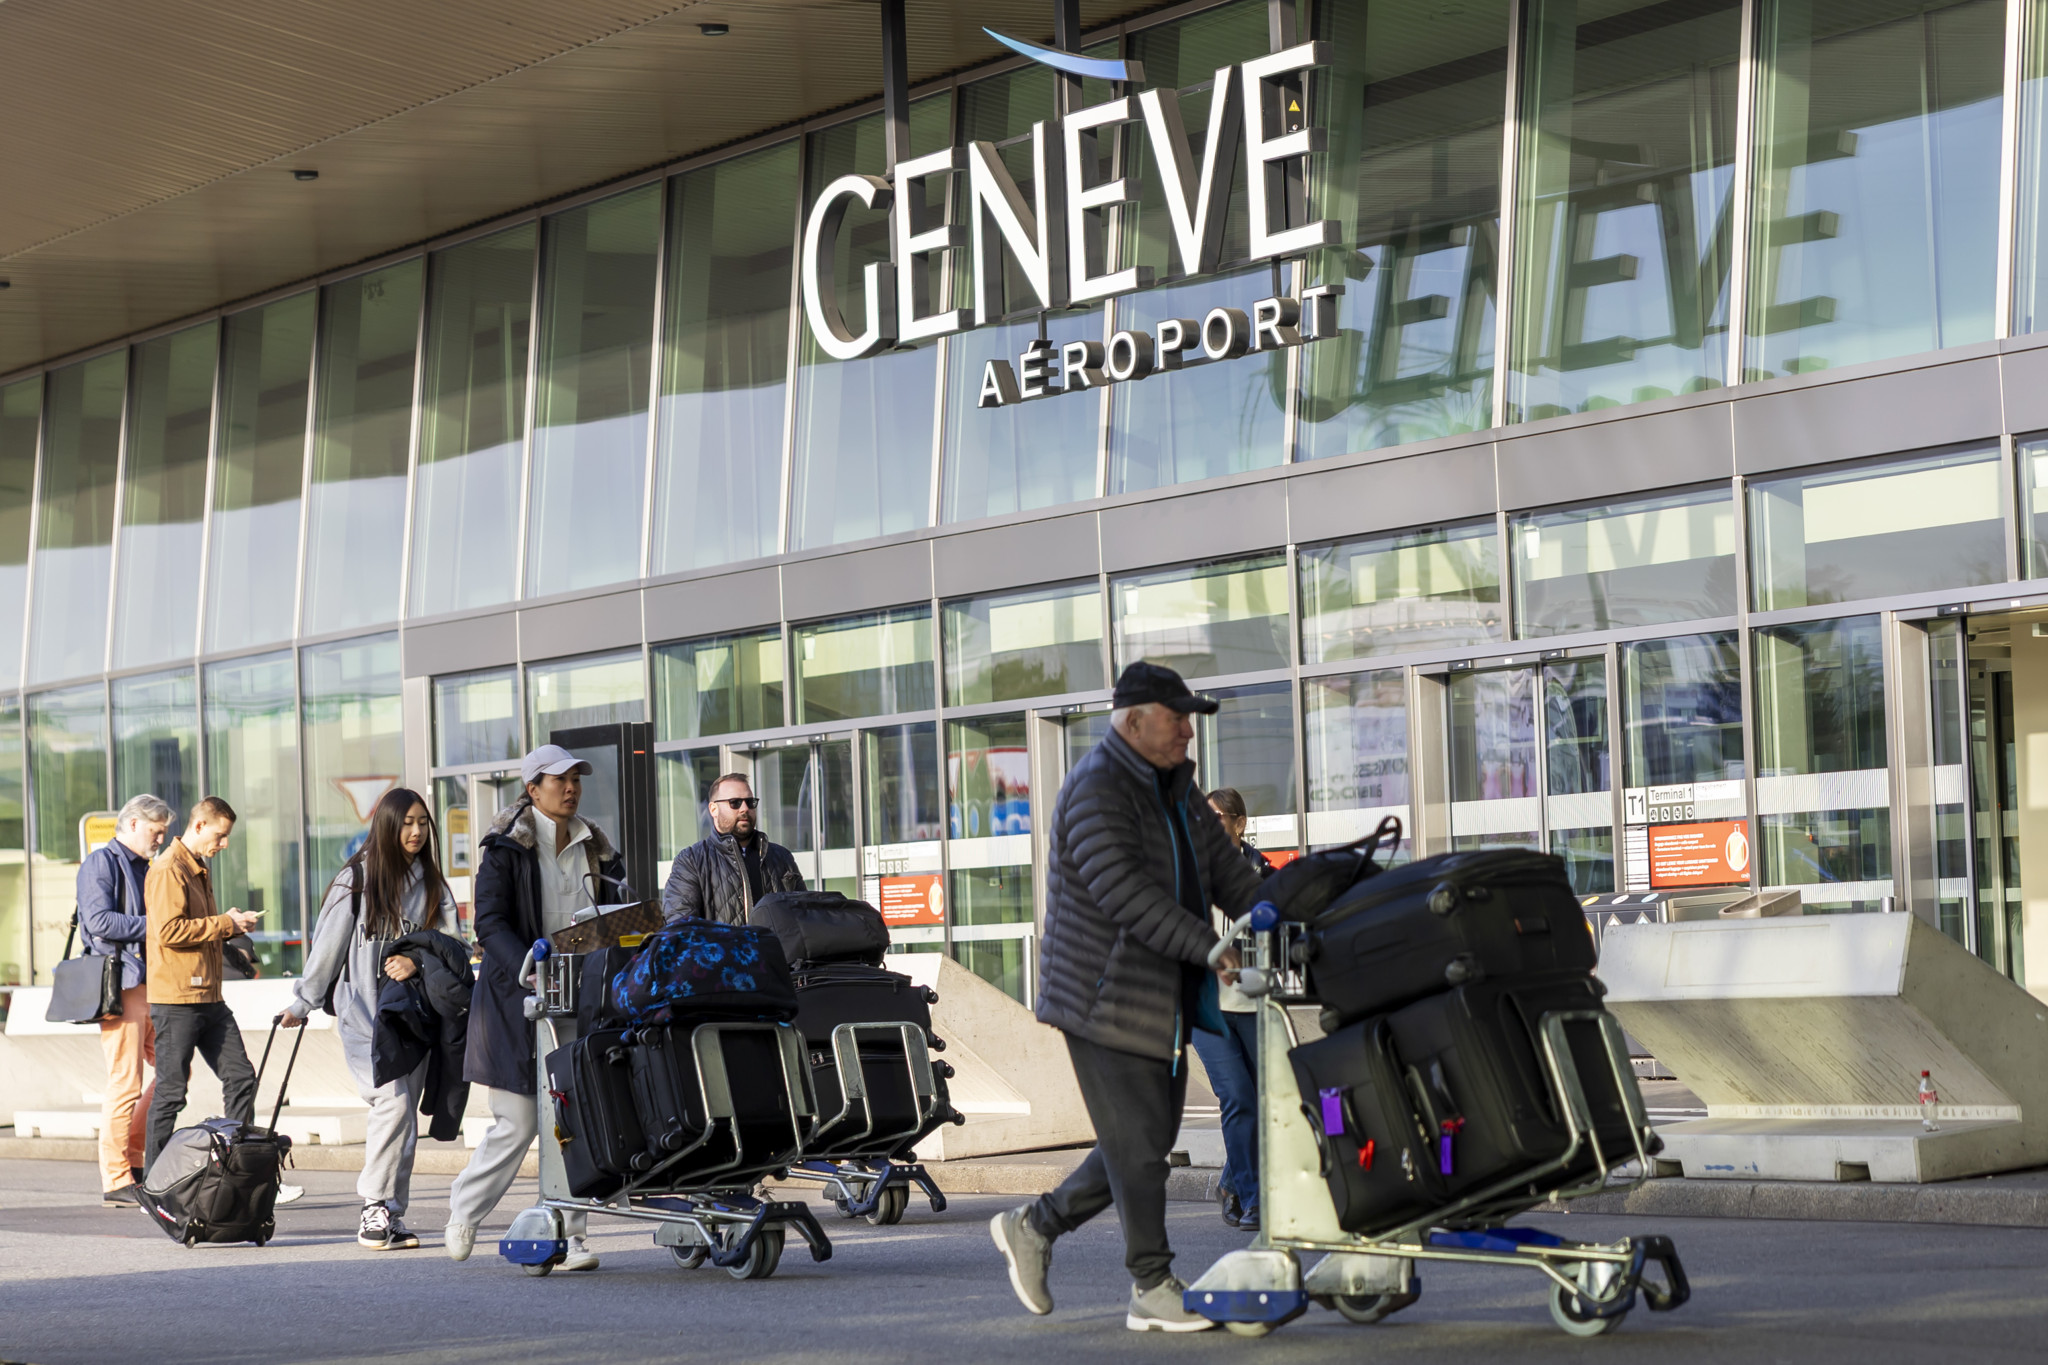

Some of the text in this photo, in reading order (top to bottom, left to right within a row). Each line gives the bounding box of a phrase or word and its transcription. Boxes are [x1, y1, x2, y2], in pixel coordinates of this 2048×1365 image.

[802, 27, 1328, 360] GENÈVE
[977, 285, 1330, 408] AÉROPORT
[1628, 795, 1645, 816] T1
[1650, 786, 1686, 802] Terminal
